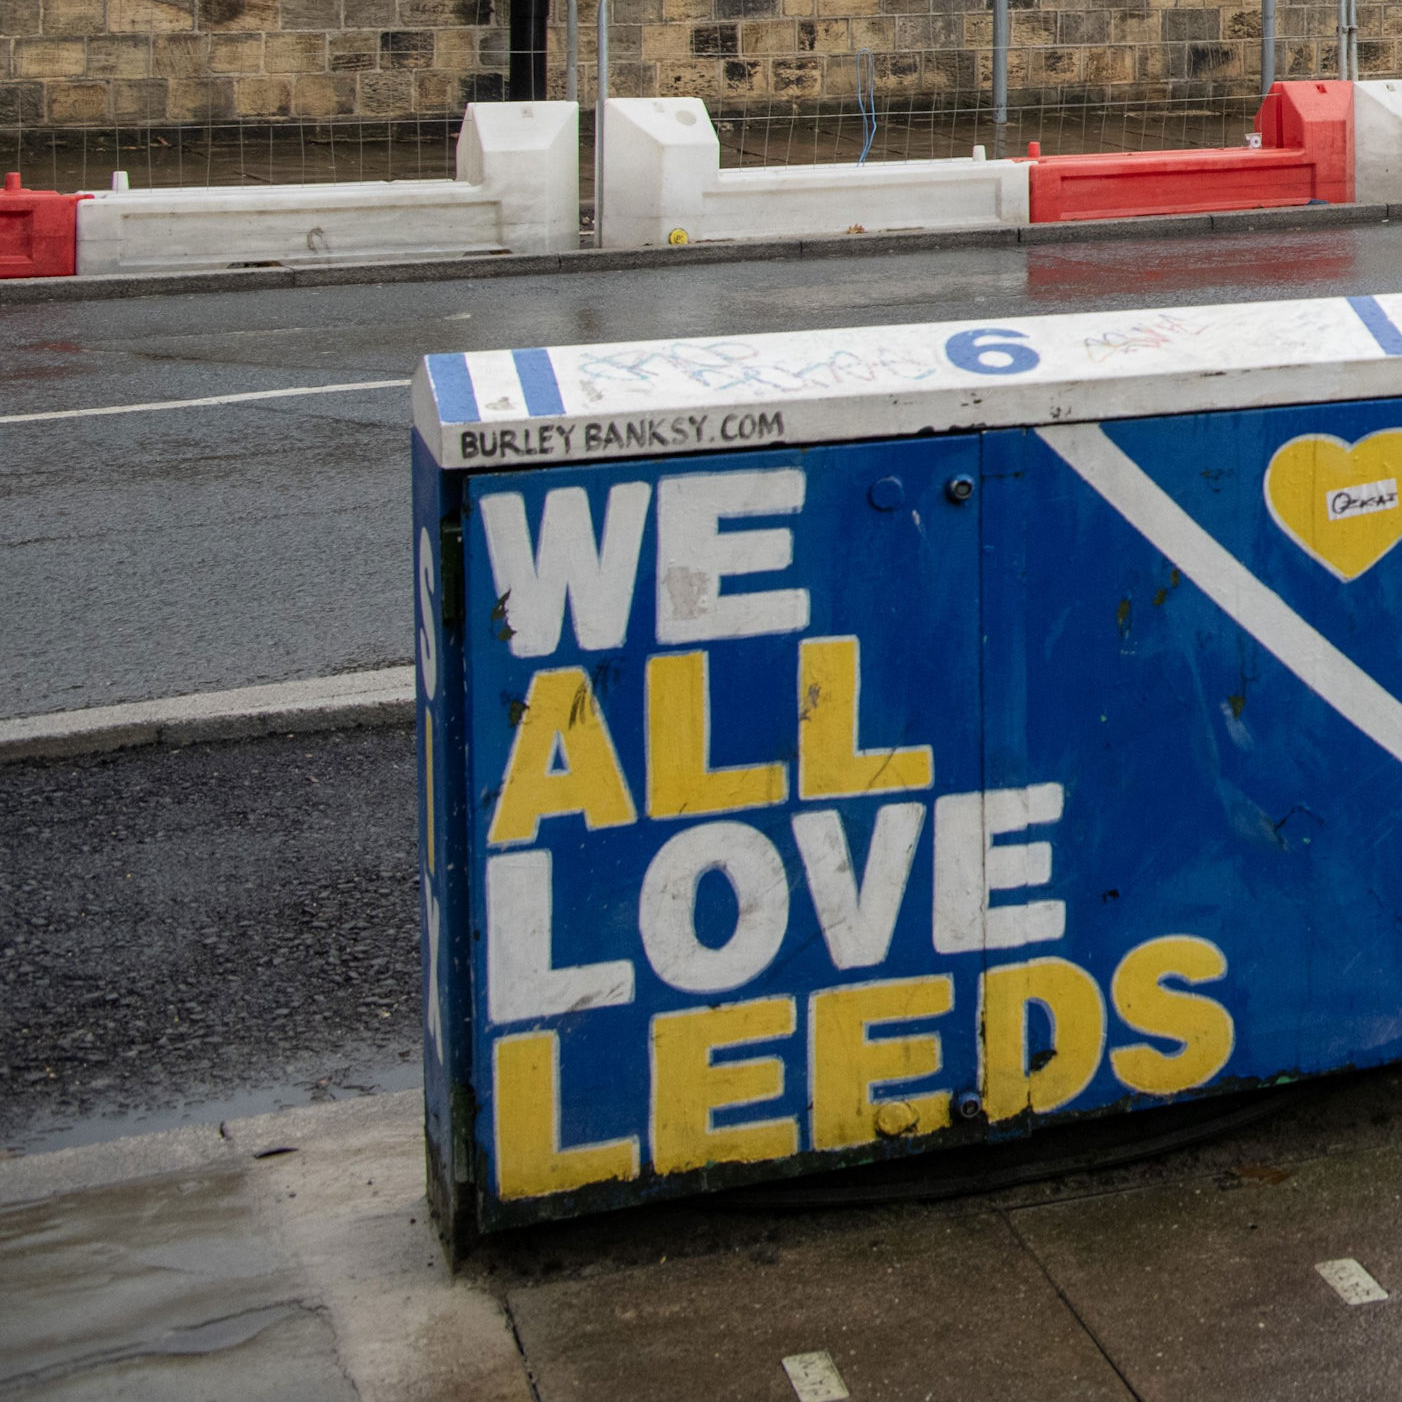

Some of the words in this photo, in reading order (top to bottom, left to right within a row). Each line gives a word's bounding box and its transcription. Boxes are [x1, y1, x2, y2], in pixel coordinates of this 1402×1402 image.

[461, 423, 575, 460] BURLEY
[945, 327, 1041, 376] 6
[478, 466, 811, 659] WE
[486, 634, 934, 847] ALL
[485, 782, 1067, 1025] LOVE
[492, 934, 1237, 1202] LEEDS
